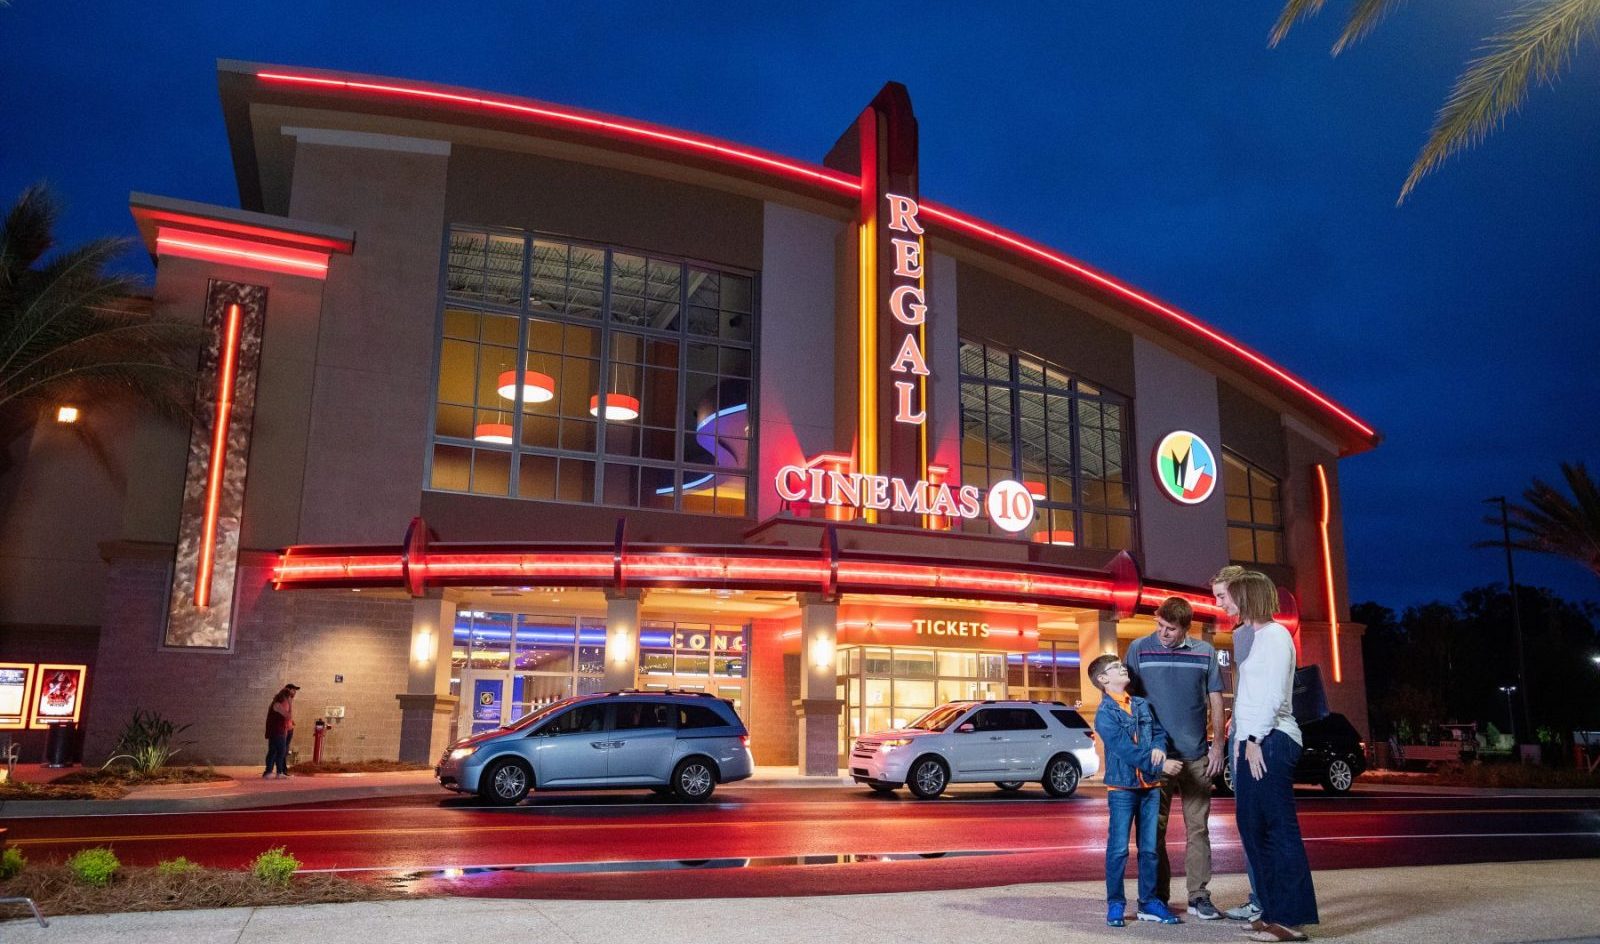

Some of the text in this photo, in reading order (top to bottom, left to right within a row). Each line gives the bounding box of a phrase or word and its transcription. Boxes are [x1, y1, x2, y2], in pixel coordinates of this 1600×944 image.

[885, 193, 930, 424] REGAL
[774, 464, 1032, 521] CINEMAS 10
[911, 619, 991, 638] TICKETS
